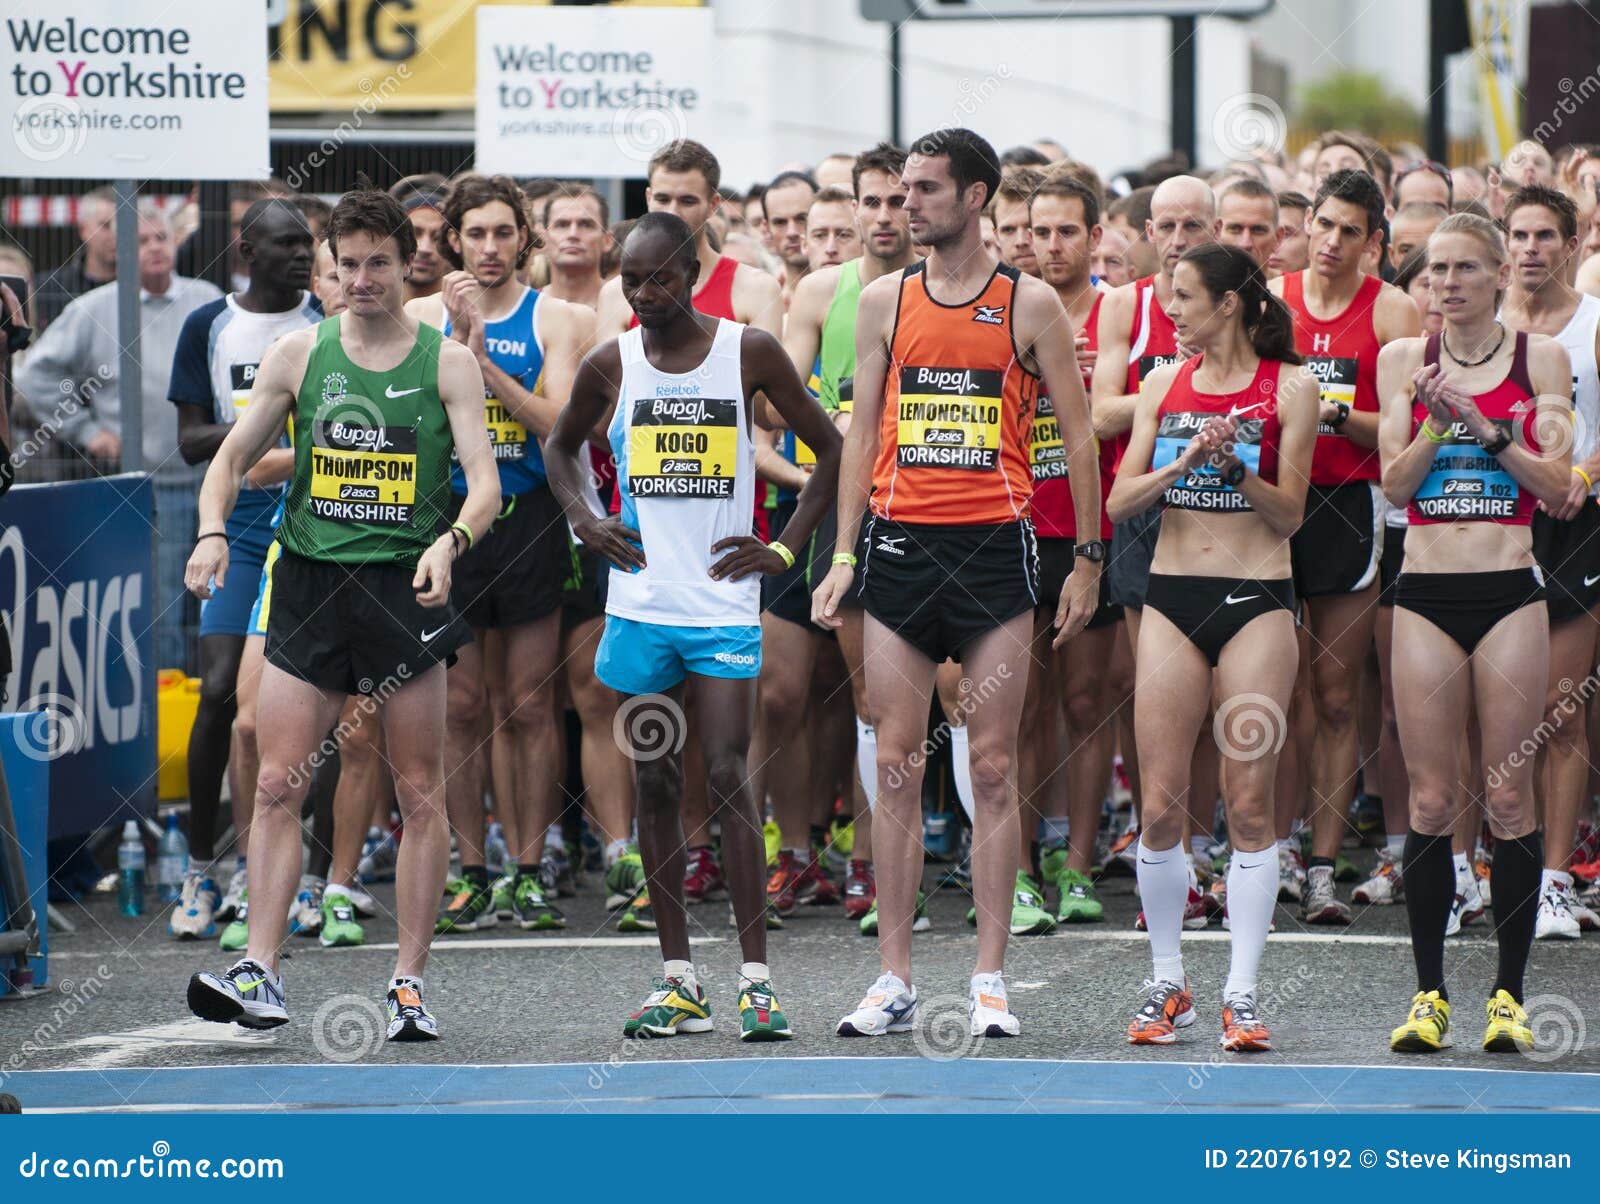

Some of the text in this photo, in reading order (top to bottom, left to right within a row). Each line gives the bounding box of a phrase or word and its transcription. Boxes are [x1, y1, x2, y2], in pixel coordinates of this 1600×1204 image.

[7, 17, 190, 54] Welcome
[494, 43, 653, 73] Welcome
[12, 61, 246, 99] to Yorkshire
[498, 78, 698, 109] to Yorkshire
[14, 109, 183, 132] yorkshire.com
[916, 367, 965, 389] Bupa
[651, 399, 699, 419] Bupa
[899, 402, 998, 425] LEMONCELLO
[332, 422, 379, 444] Bupa
[504, 430, 517, 441] 22
[655, 432, 709, 454] KOGO
[937, 431, 985, 447] asics 3
[899, 446, 993, 466] YORKSHIRE
[314, 454, 413, 482] THOMPSON
[673, 462, 721, 476] asics 2
[351, 488, 399, 503] asics 1
[632, 476, 730, 495] YORKSHIRE
[1456, 482, 1512, 497] asics 102
[315, 499, 408, 521] YORKSHIRE
[1417, 497, 1514, 516] YORKSHIRE
[29, 573, 143, 756] asics
[714, 652, 755, 665] Reebok
